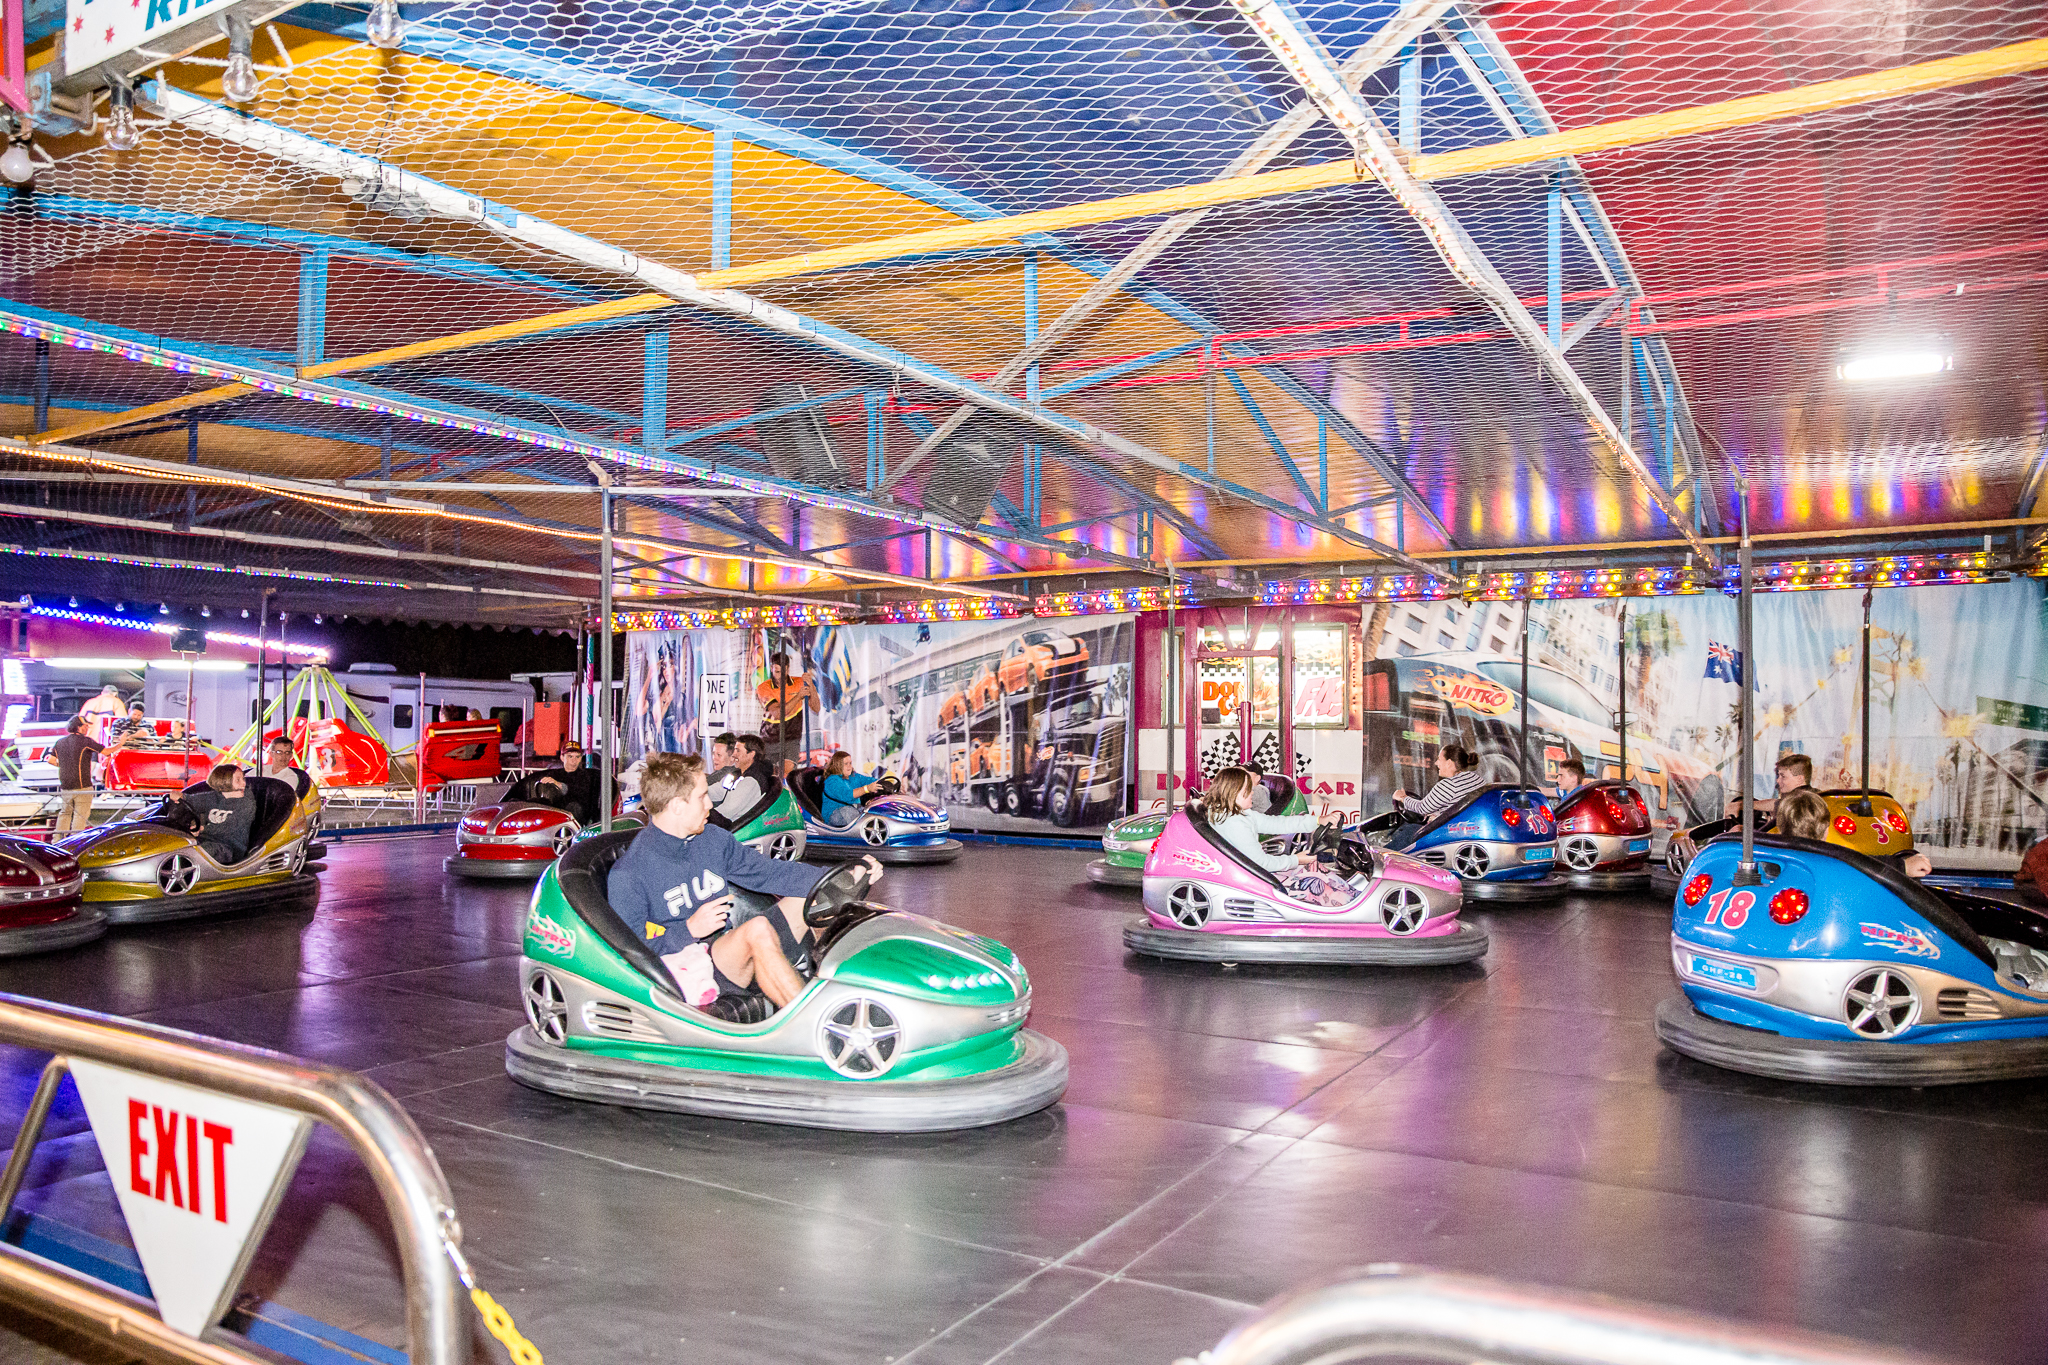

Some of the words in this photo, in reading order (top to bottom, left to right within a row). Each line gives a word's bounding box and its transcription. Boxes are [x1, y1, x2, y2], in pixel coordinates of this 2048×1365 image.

[1449, 684, 1509, 707] NITRO
[707, 700, 725, 713] AY
[1296, 776, 1355, 795] CAR
[1526, 814, 1548, 834] 13
[1870, 823, 1889, 844] 3
[1172, 853, 1211, 866] NITRO
[663, 869, 725, 917] FILA
[1704, 887, 1756, 930] 18
[531, 924, 572, 947] NITRO
[1860, 925, 1924, 946] NITRO
[127, 1097, 234, 1225] EXIT
